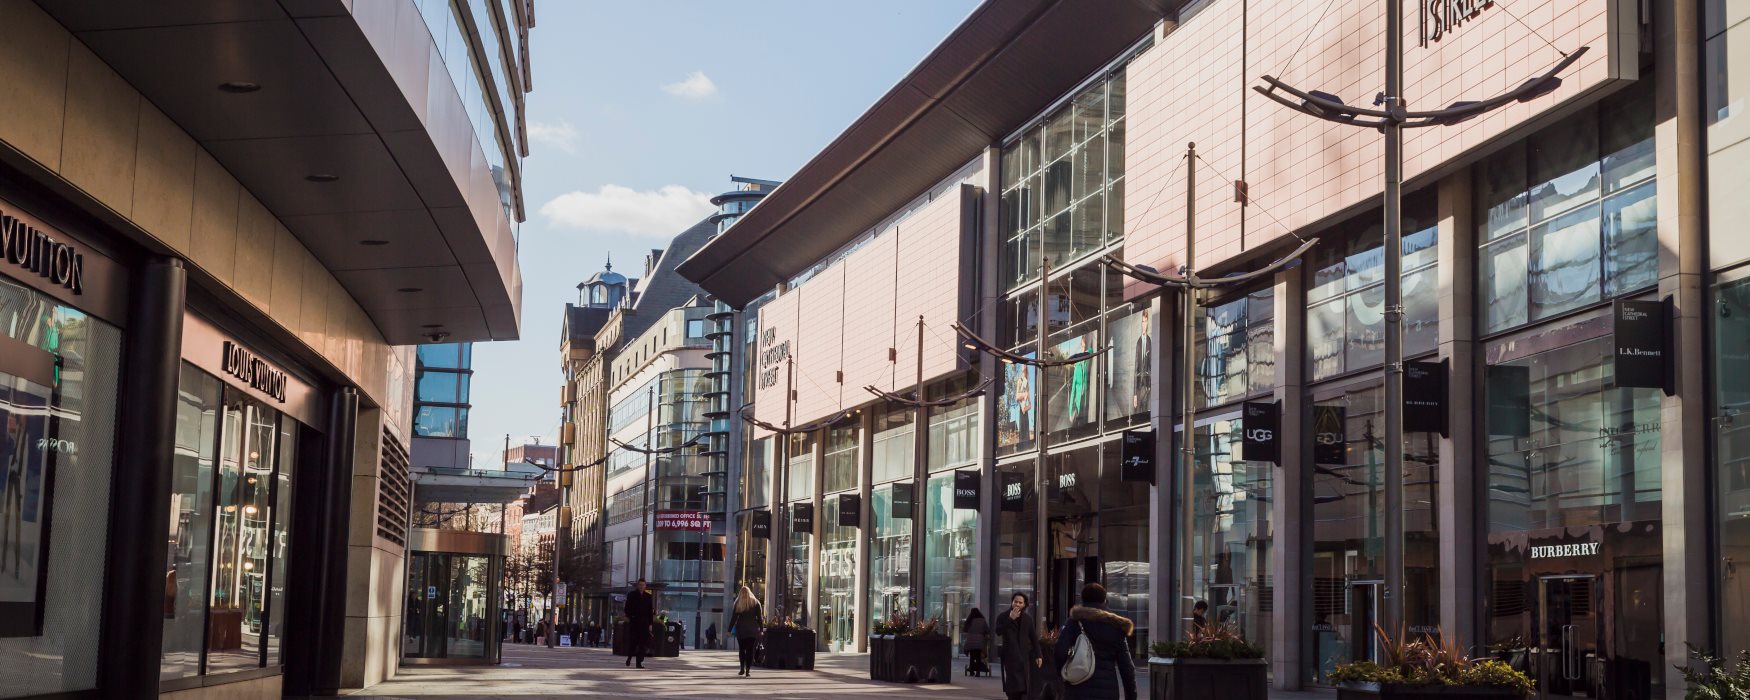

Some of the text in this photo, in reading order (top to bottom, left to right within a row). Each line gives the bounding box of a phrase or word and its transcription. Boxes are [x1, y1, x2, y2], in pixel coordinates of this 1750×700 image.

[0, 211, 84, 292] VUITTON
[224, 341, 287, 403] LOUIS VUITTON
[1246, 428, 1273, 442] UGG
[1059, 473, 1076, 488] BOSS
[956, 488, 976, 497] BOSS
[1006, 482, 1022, 497] BOSS
[671, 520, 689, 528] 6,996
[690, 520, 701, 528] SQ
[702, 520, 711, 528] FT
[1531, 542, 1599, 558] BURBERRY
